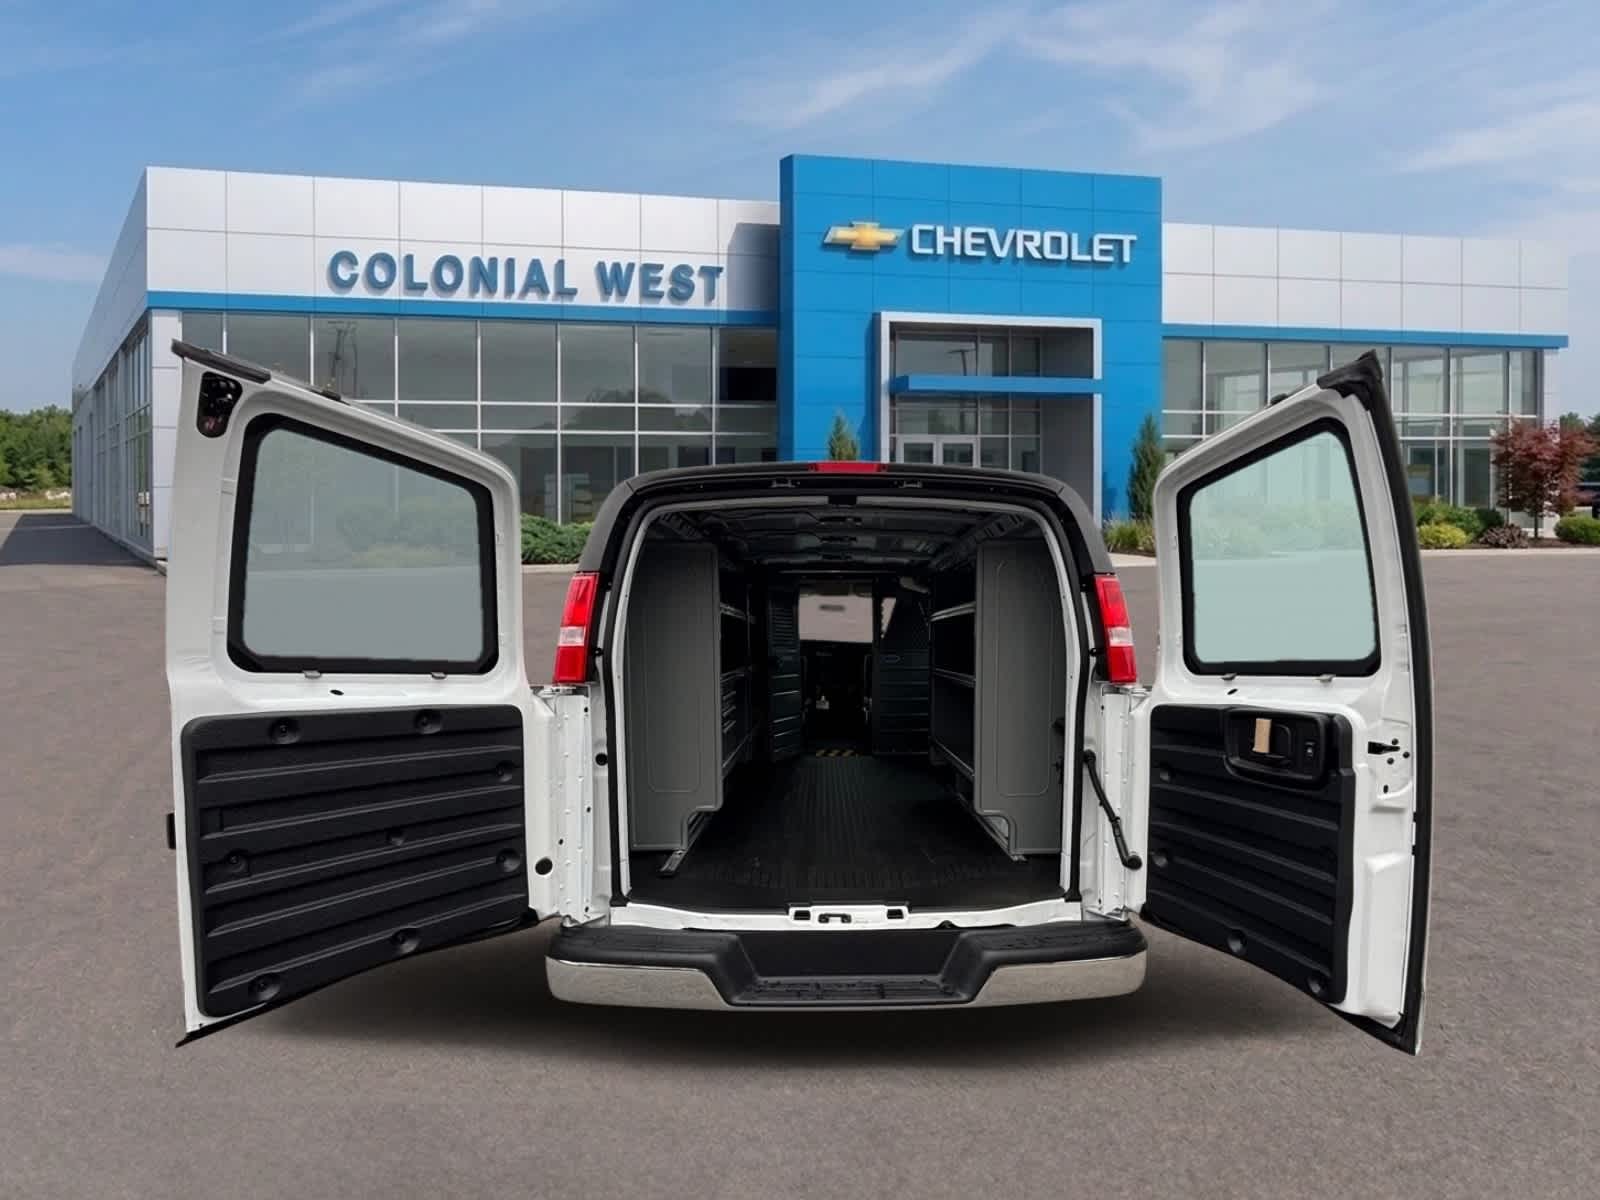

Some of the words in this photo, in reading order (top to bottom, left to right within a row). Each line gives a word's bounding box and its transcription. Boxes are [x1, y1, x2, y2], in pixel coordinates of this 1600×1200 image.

[911, 223, 1138, 264] CHEVROLET
[328, 250, 578, 297] COLONIAL
[595, 261, 724, 303] WEST
